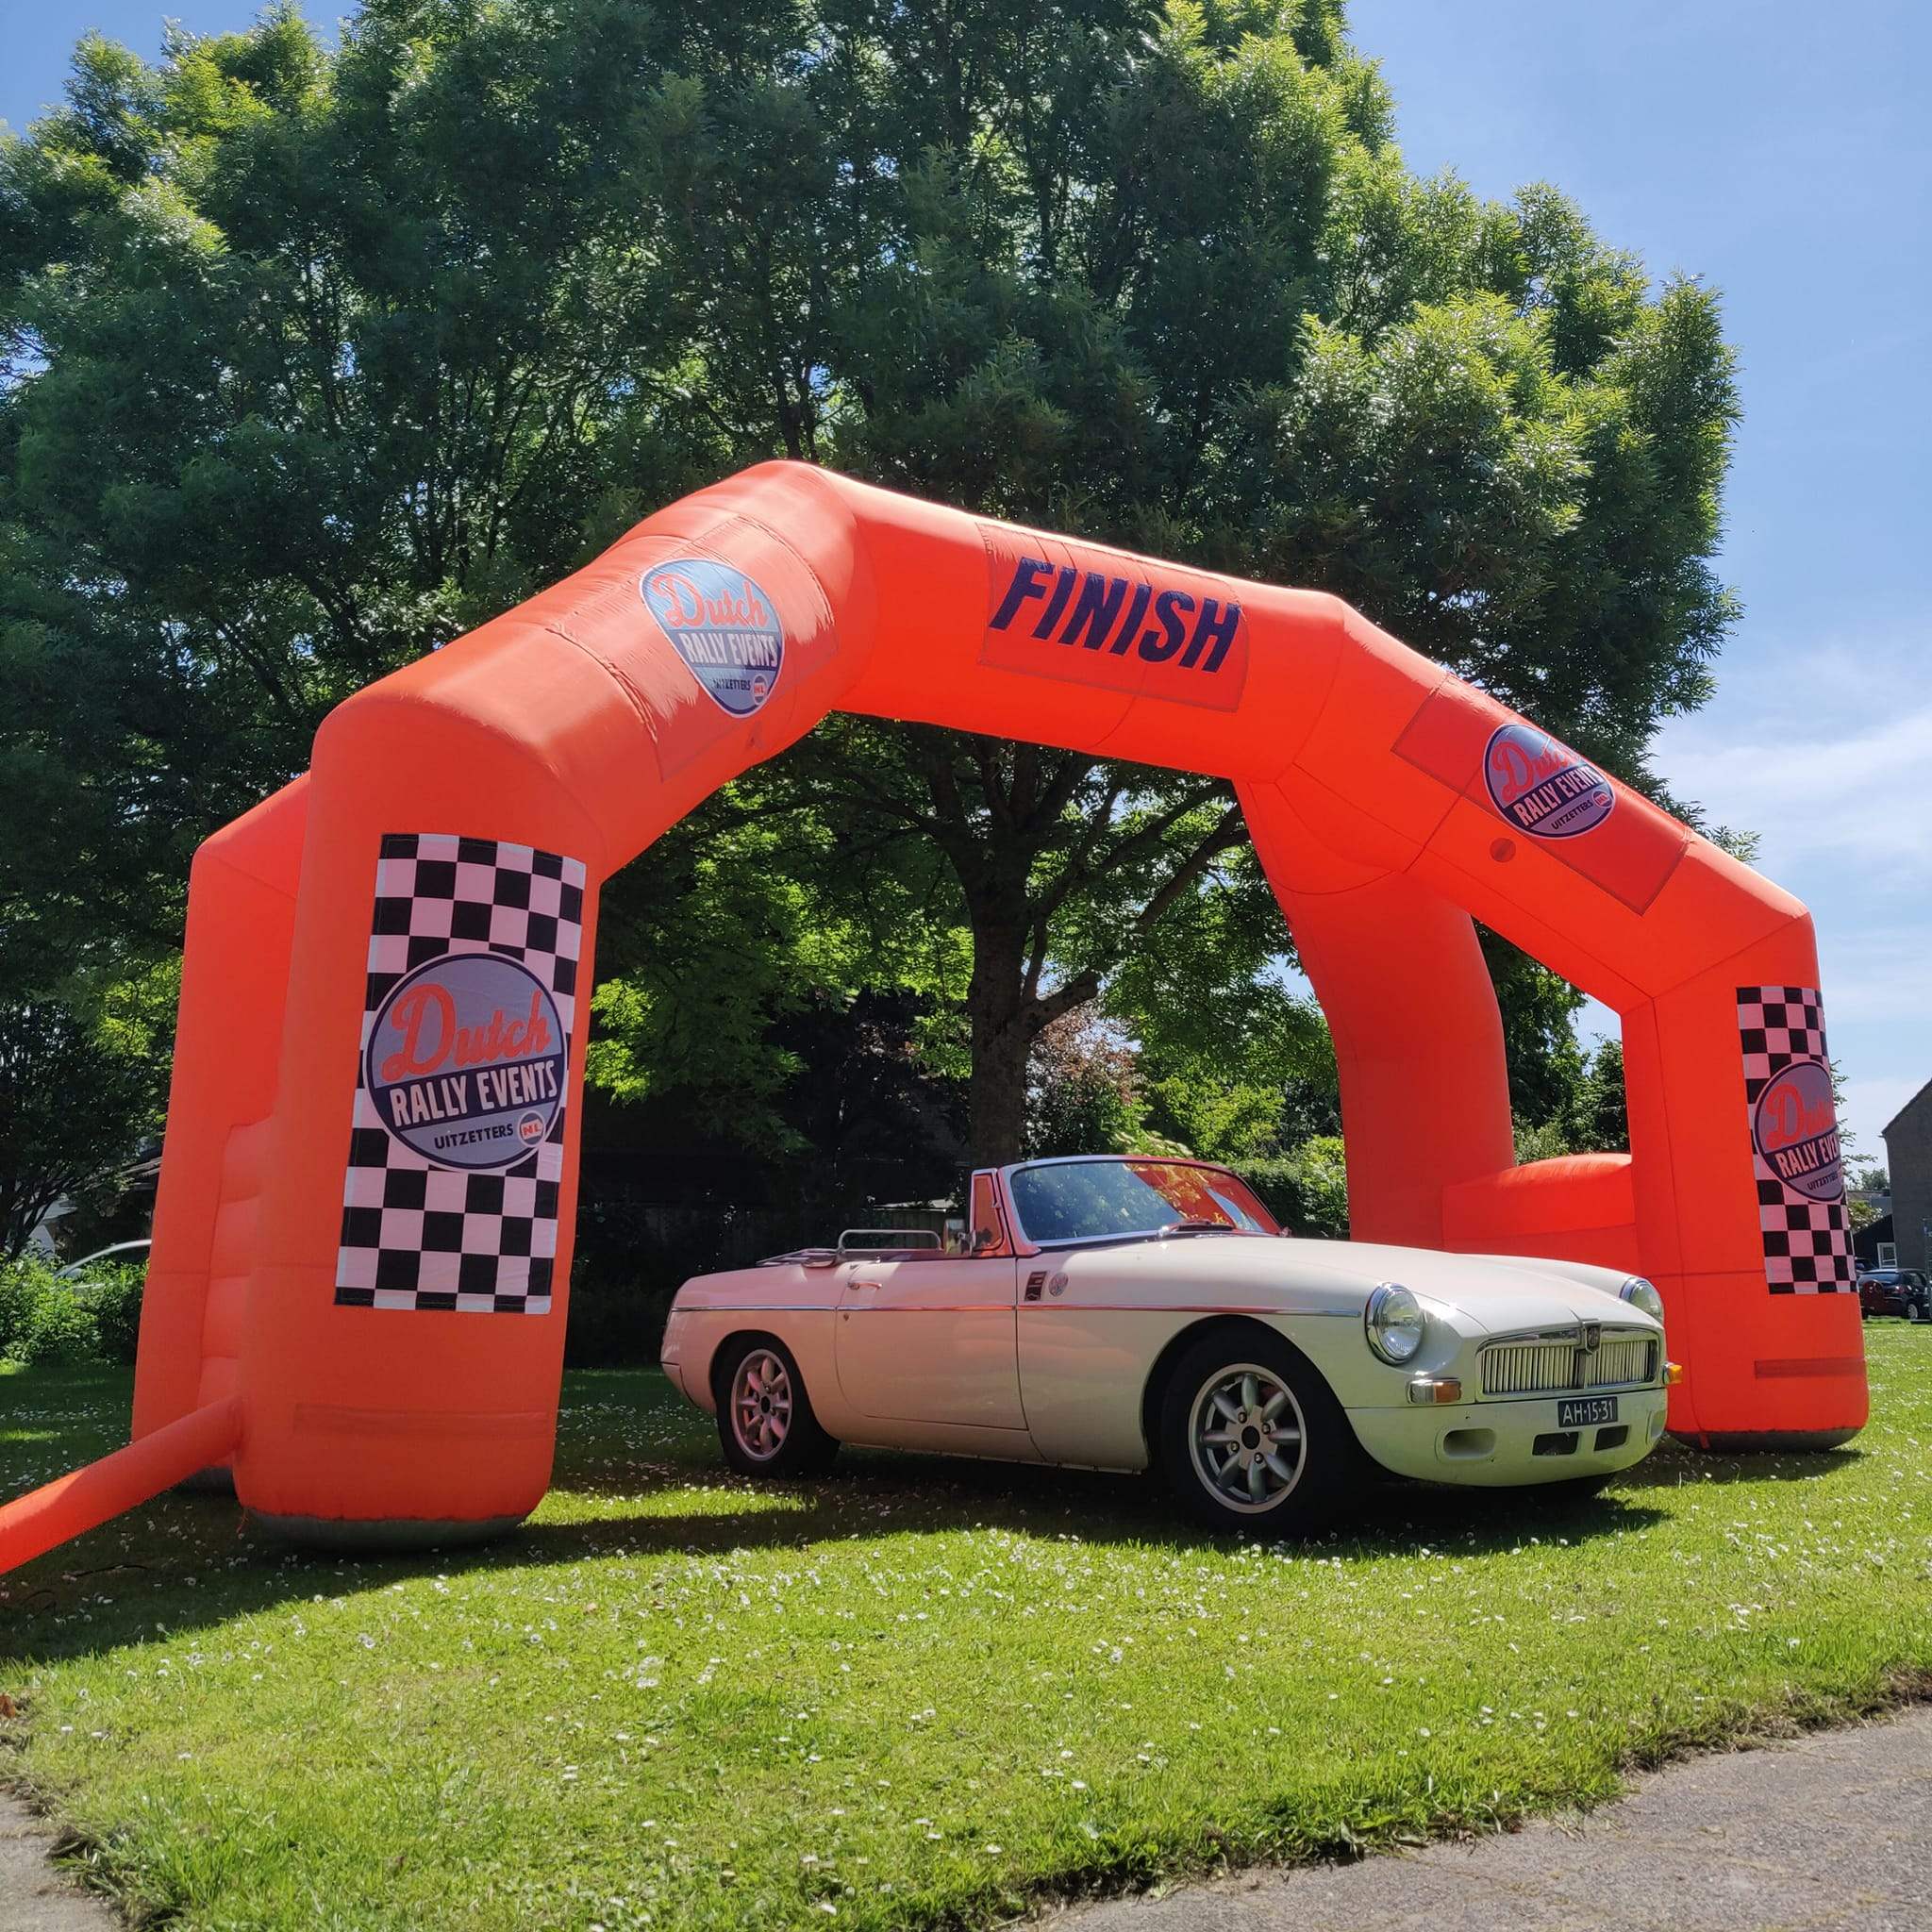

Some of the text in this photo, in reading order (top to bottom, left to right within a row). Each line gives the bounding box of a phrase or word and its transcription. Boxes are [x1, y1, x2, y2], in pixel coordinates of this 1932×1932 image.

[651, 573, 770, 627] Dutch
[989, 557, 1242, 673] FINISH
[679, 632, 778, 666] RALLY EVENTS
[1513, 783, 1561, 826] RALLY
[1551, 799, 1593, 829] UITZETTERS
[381, 983, 552, 1083] Dutch
[390, 1059, 558, 1126] RALLY EVENTS
[435, 1124, 514, 1150] UITZETTERS
[523, 1124, 541, 1136] NL
[1774, 1141, 1820, 1178] RALLY
